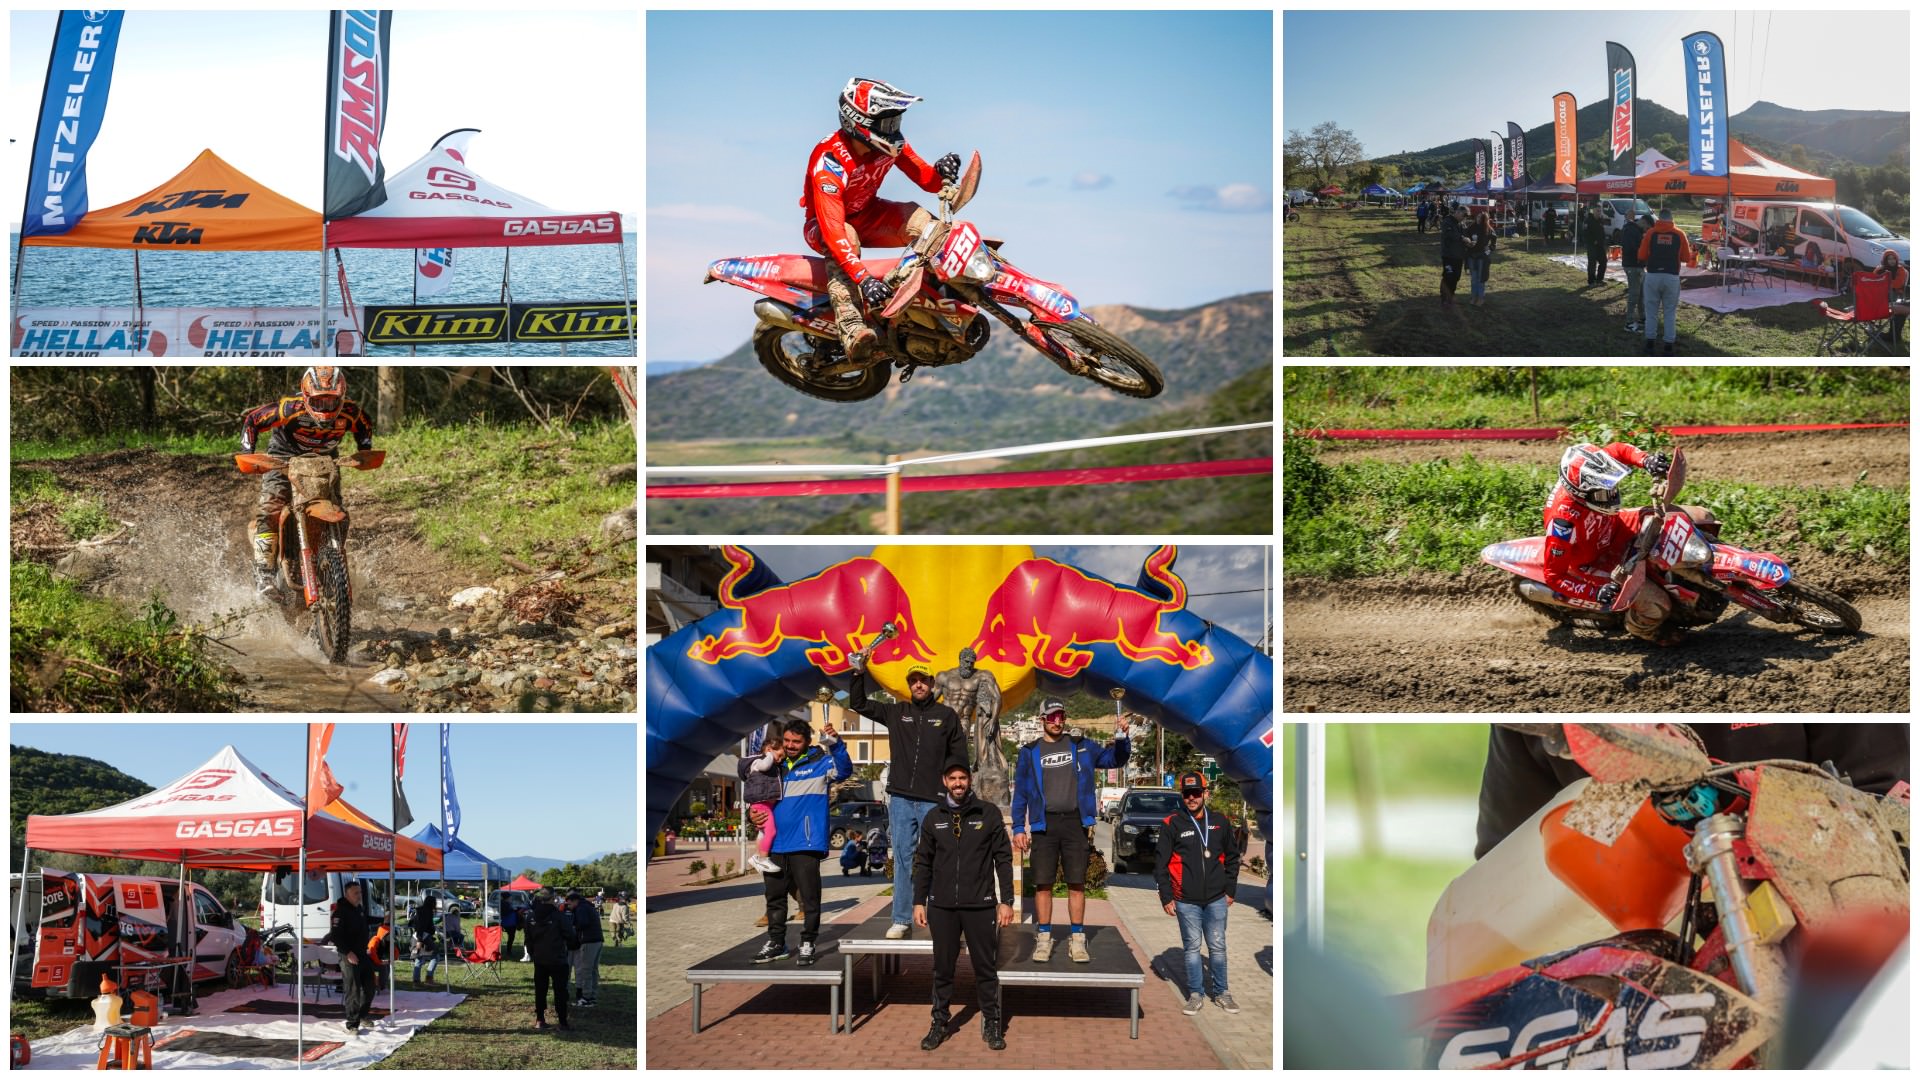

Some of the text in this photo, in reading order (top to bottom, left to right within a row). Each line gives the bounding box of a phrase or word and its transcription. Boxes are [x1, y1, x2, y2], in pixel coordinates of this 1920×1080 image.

[42, 25, 102, 226] METZELER
[1664, 179, 1688, 190] KTM
[1775, 180, 1799, 192] KTM
[122, 189, 250, 217] KTM
[408, 191, 513, 209] GASGAS
[132, 221, 204, 245] KTM
[503, 217, 615, 237] GASGAS
[835, 238, 860, 265] FXR
[942, 225, 978, 279] 251
[212, 320, 242, 328] SPEED
[253, 320, 295, 328] PASSION
[377, 313, 496, 336] Klim
[808, 317, 839, 336] 25
[22, 329, 150, 350] HELLAS
[1662, 515, 1691, 566] 251
[1567, 598, 1603, 610] 25
[1042, 753, 1072, 765] HJC
[1167, 775, 1173, 784] P
[176, 818, 295, 838] GASGAS
[1180, 830, 1195, 838] KTM
[362, 833, 392, 852] GASGAS
